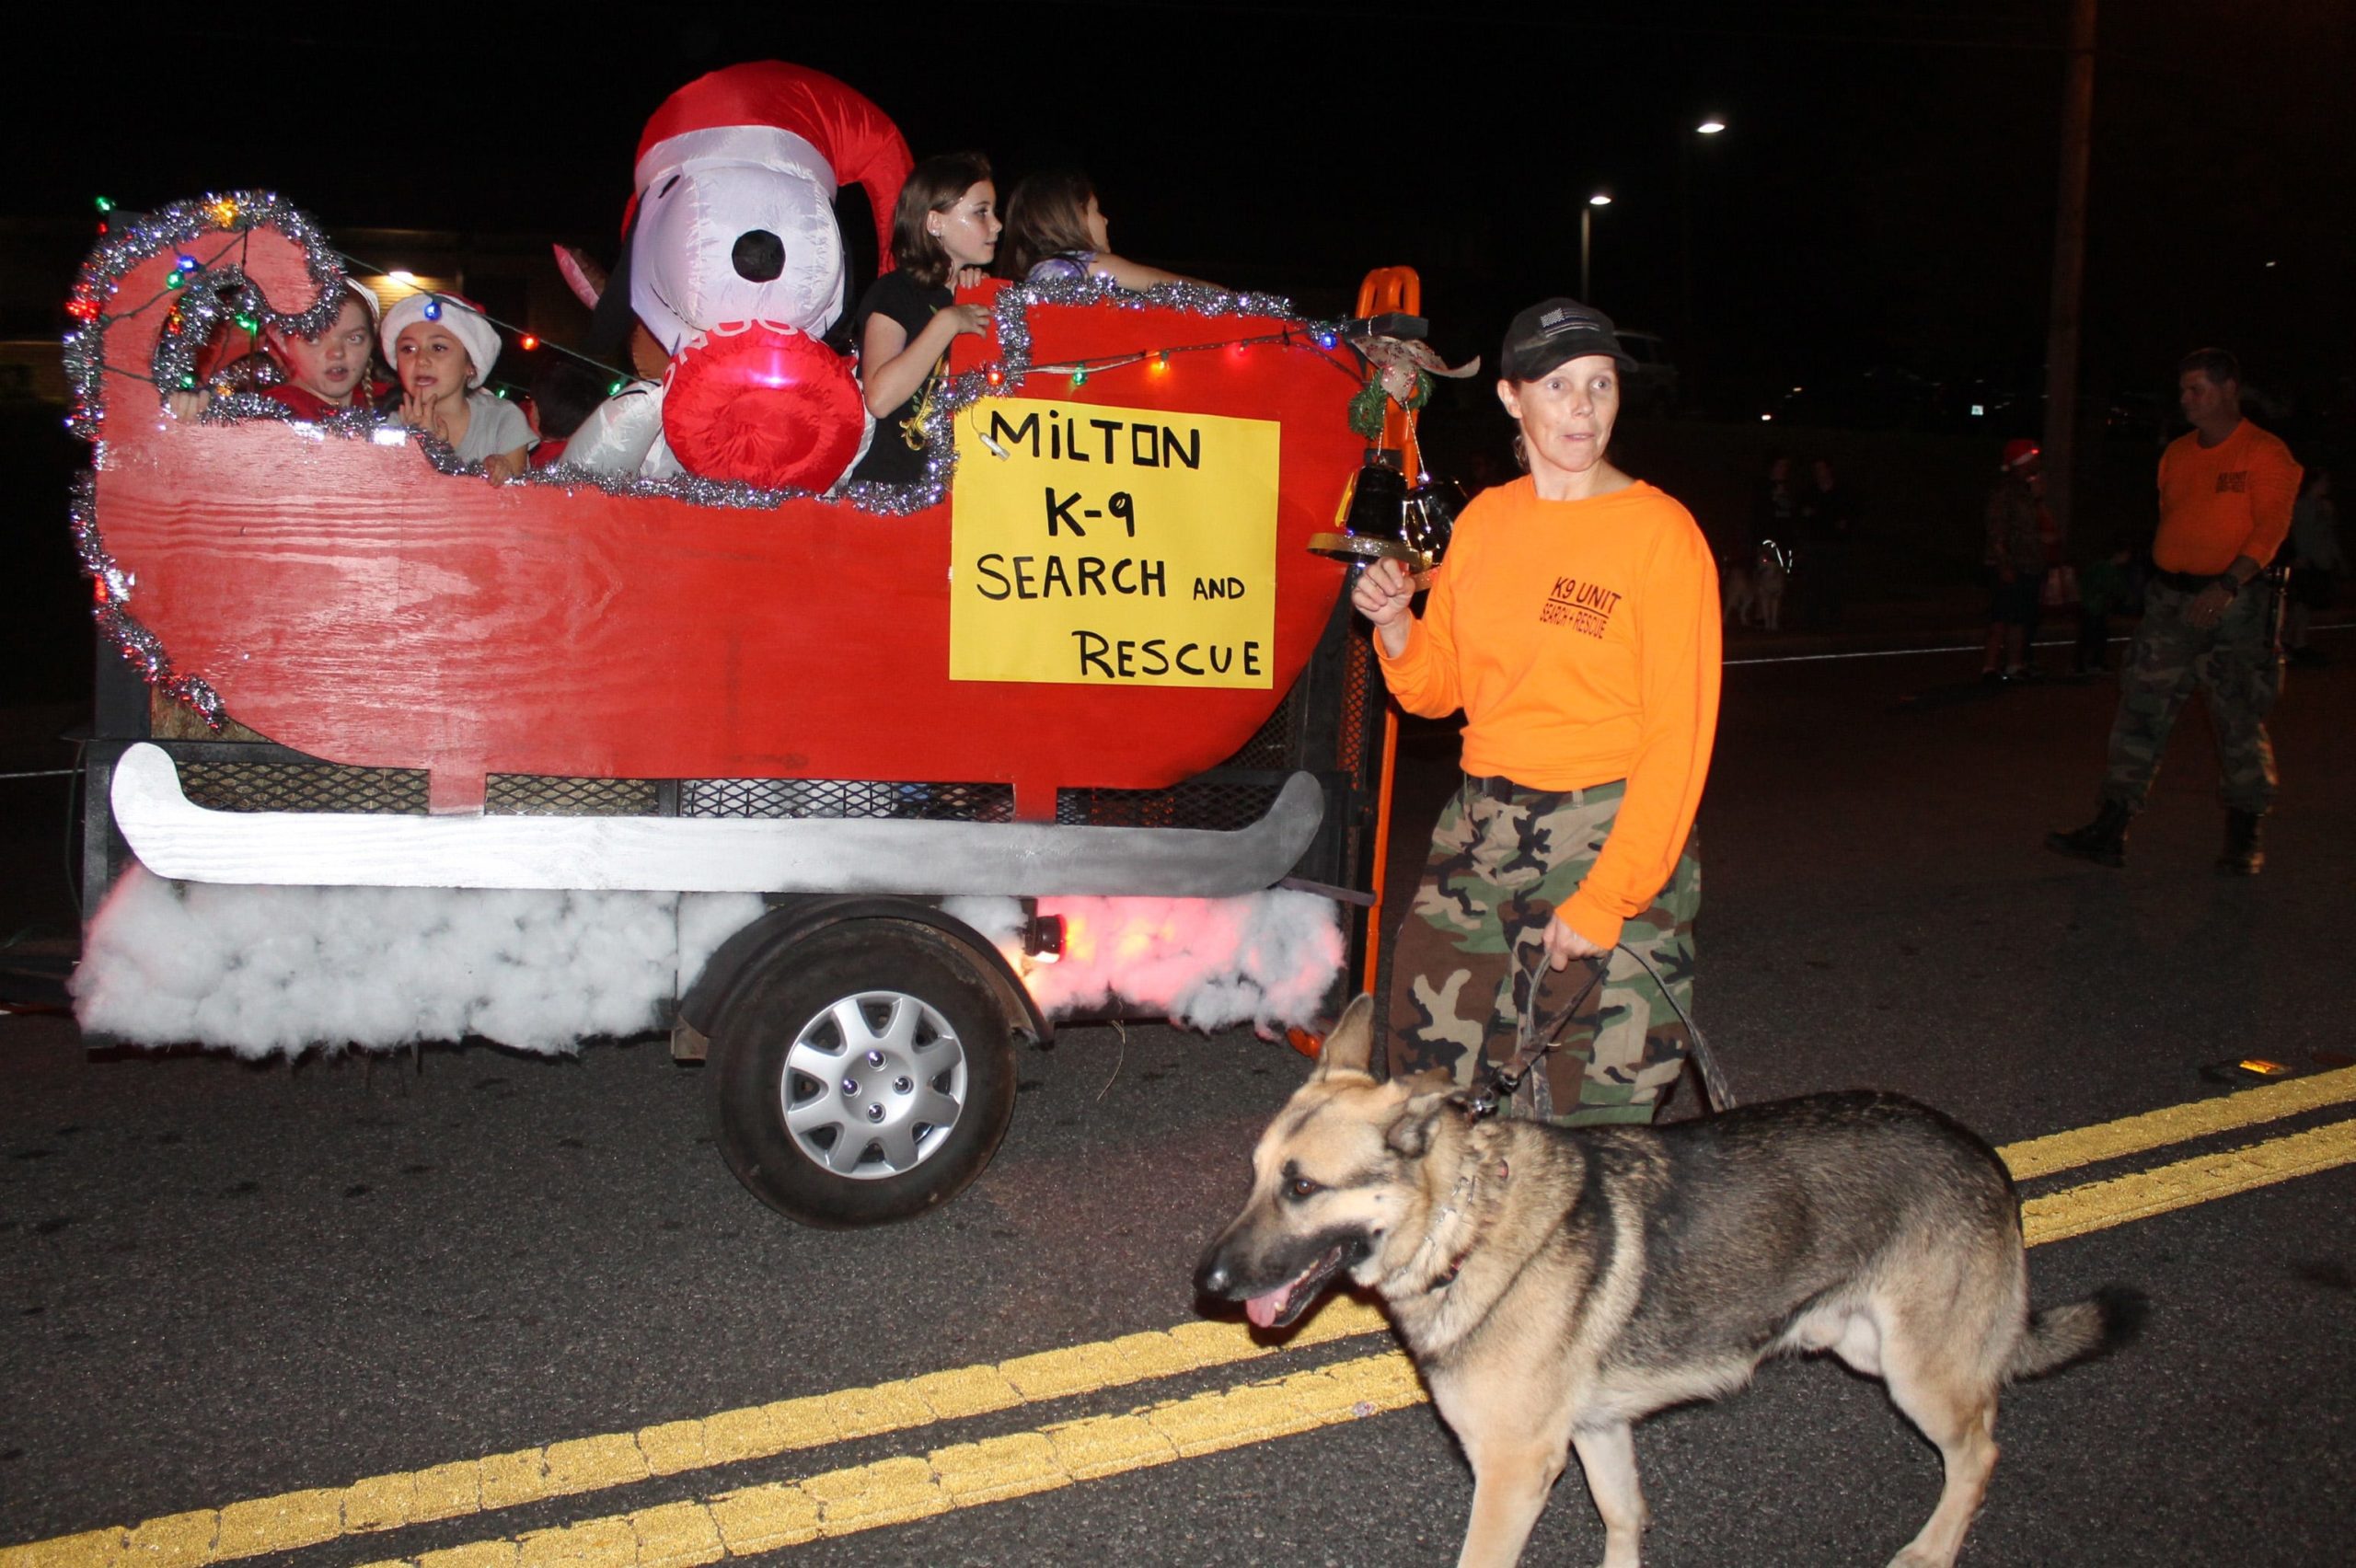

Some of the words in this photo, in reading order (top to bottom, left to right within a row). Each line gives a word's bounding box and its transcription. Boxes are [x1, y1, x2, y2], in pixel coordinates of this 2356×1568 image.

[1045, 486, 1136, 537] K-9
[976, 553, 1167, 601] SEARCH
[1193, 576, 1246, 601] AND
[1551, 576, 1576, 599] K9
[1576, 582, 1622, 614] UNIT
[1539, 603, 1568, 626] SEARCH
[1574, 611, 1607, 639] RESCUE
[1070, 629, 1262, 679] RESCUE
